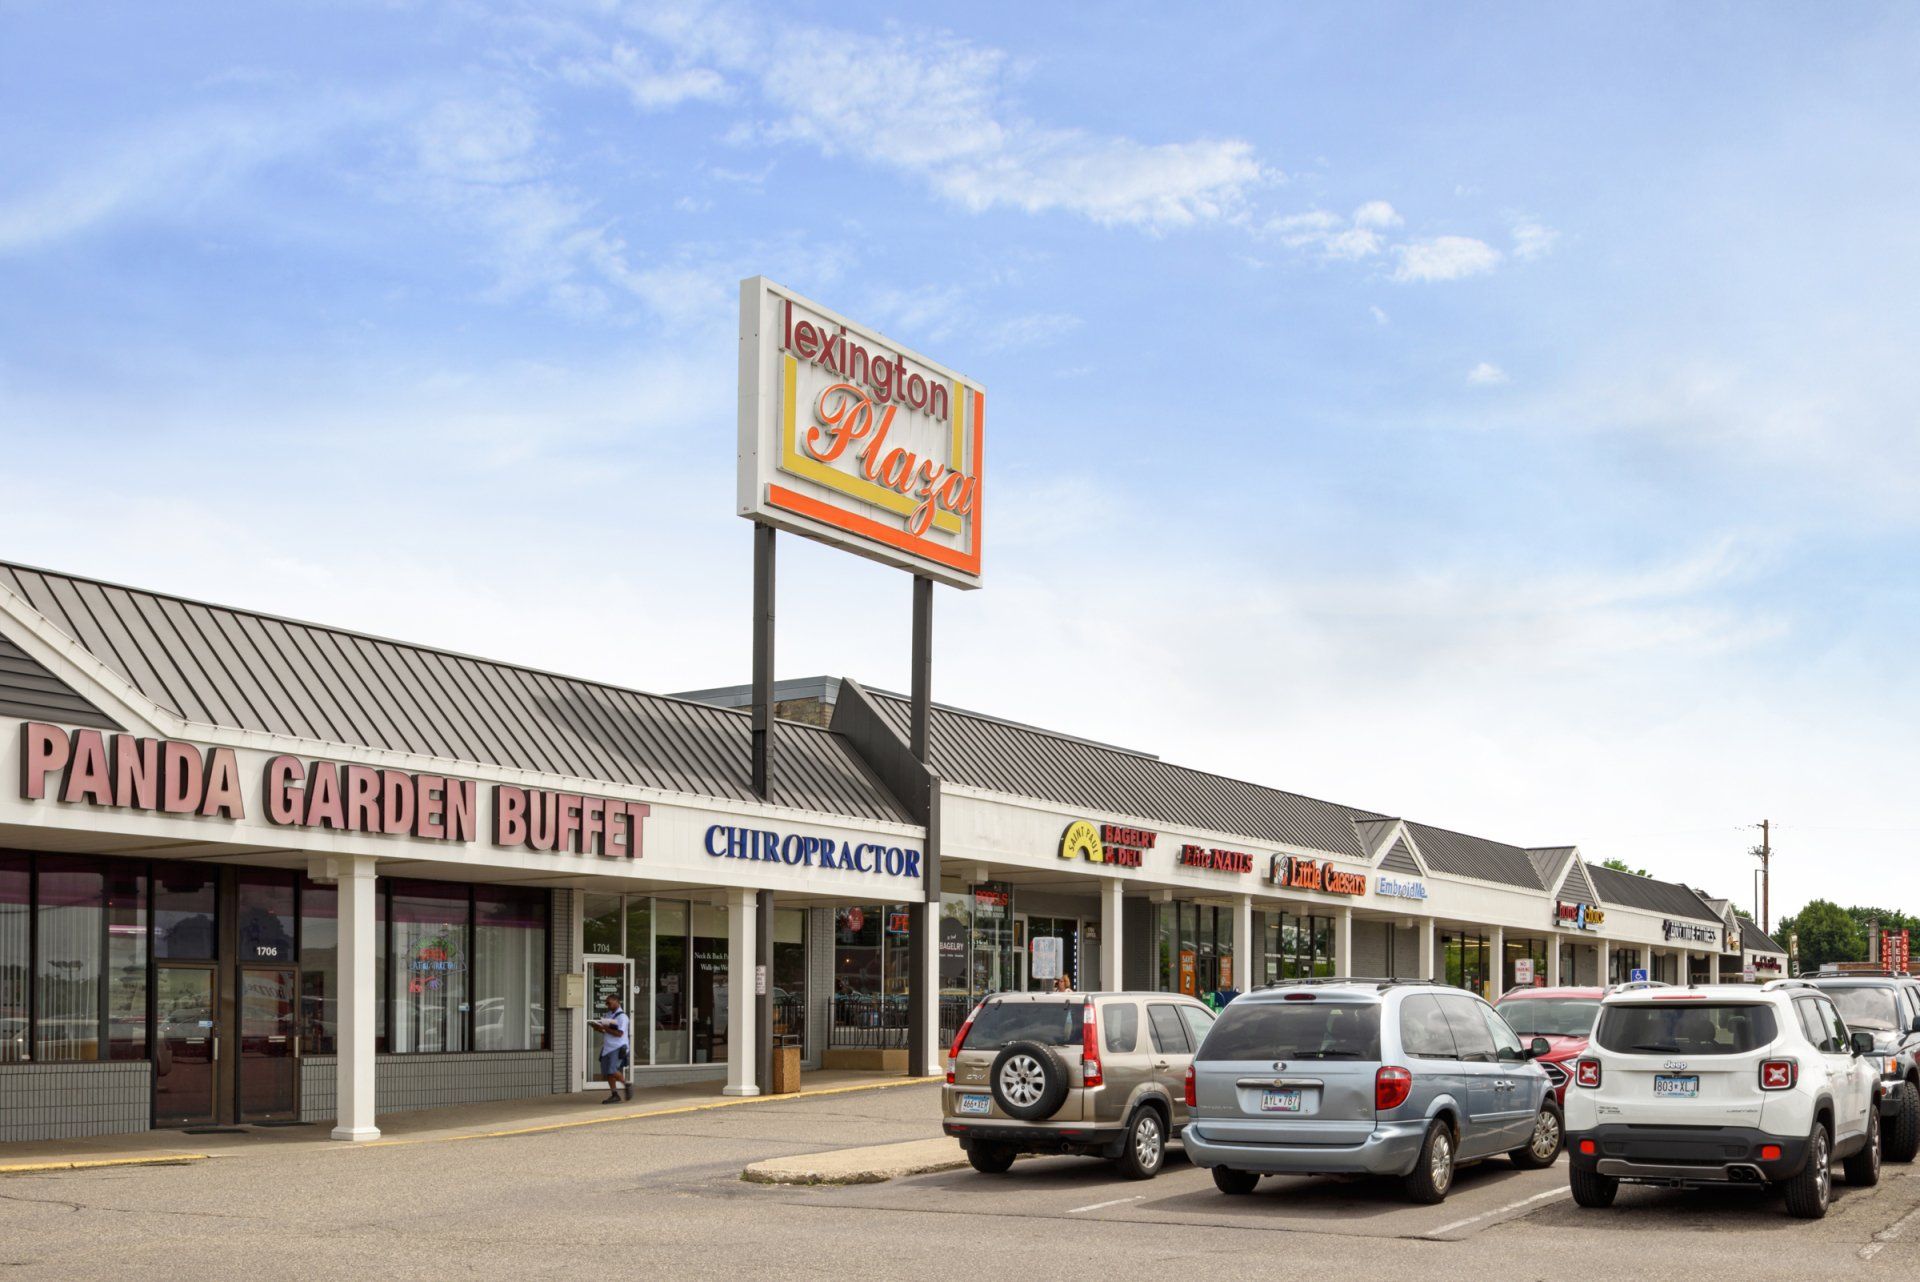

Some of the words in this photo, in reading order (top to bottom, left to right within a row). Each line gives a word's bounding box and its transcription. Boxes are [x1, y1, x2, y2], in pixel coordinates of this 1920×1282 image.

[784, 300, 948, 421] lexington
[806, 383, 976, 537] Plaza
[21, 722, 244, 819] PANDA
[265, 755, 476, 843] GARDEN
[492, 785, 650, 858] BUFFET
[1068, 826, 1084, 852] SAINT
[1086, 828, 1099, 854] PAUL
[1102, 824, 1157, 848] BAGELRY
[705, 824, 920, 878] CHIROPRACTOR
[1104, 846, 1114, 863] &
[1117, 847, 1142, 867] DELI
[1182, 845, 1212, 868] Elite
[1212, 848, 1253, 873] NAILS
[1290, 856, 1321, 891] Little
[1323, 861, 1366, 896] Caesars
[256, 947, 277, 956] 1706
[592, 943, 610, 953] 1704
[939, 941, 964, 951] BAGELRY
[1664, 1060, 1687, 1070] Jeep
[1657, 1081, 1674, 1092] 803
[1680, 1081, 1696, 1092] XLJ
[1264, 1095, 1278, 1106] AYL
[1283, 1095, 1298, 1106] 787
